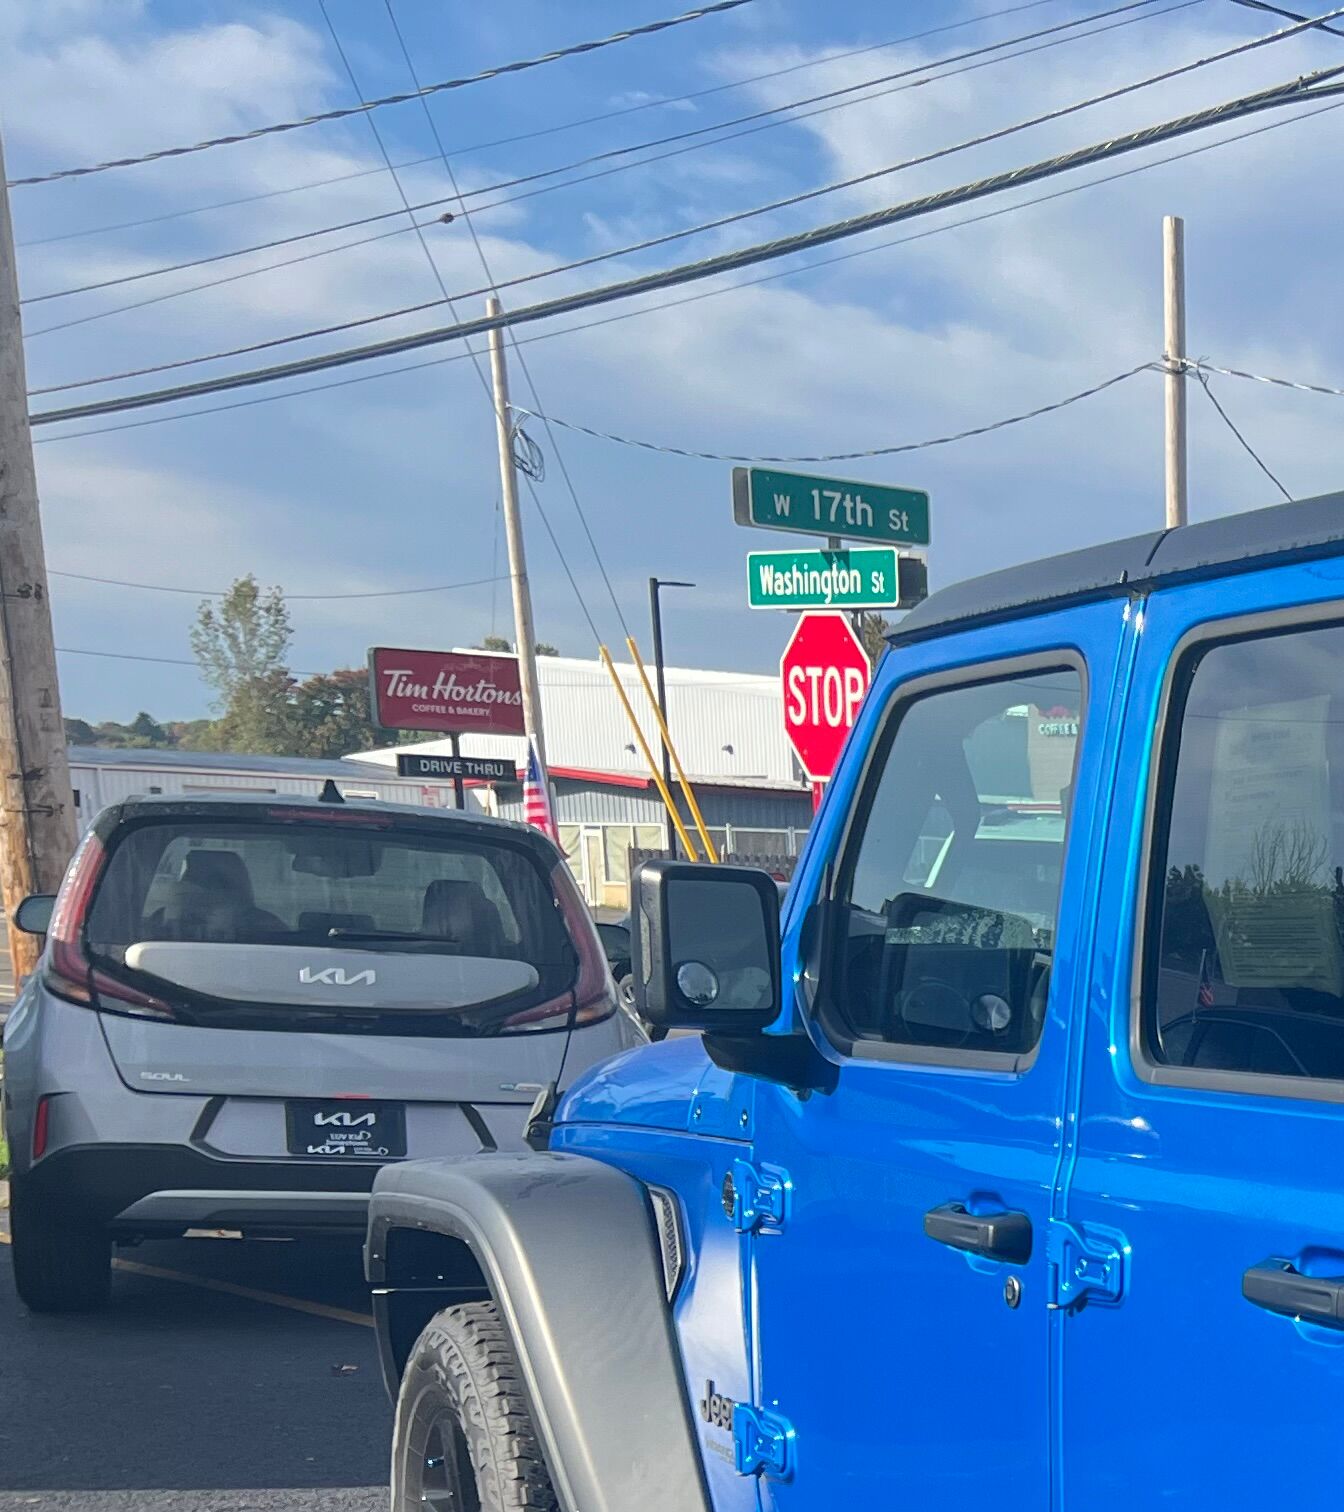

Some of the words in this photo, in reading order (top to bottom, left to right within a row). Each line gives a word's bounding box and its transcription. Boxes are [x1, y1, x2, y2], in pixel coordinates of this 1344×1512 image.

[773, 494, 790, 517] W
[811, 489, 873, 527] 17th
[889, 509, 909, 532] St
[759, 564, 862, 604] Washington
[871, 571, 885, 594] St
[383, 670, 428, 699] Tim
[431, 671, 522, 706] Hortons
[788, 665, 864, 727] STOP
[411, 704, 446, 715] COFFEE
[420, 760, 463, 774] DRIVE
[466, 762, 504, 777] THRU
[700, 1379, 733, 1431] Jee
